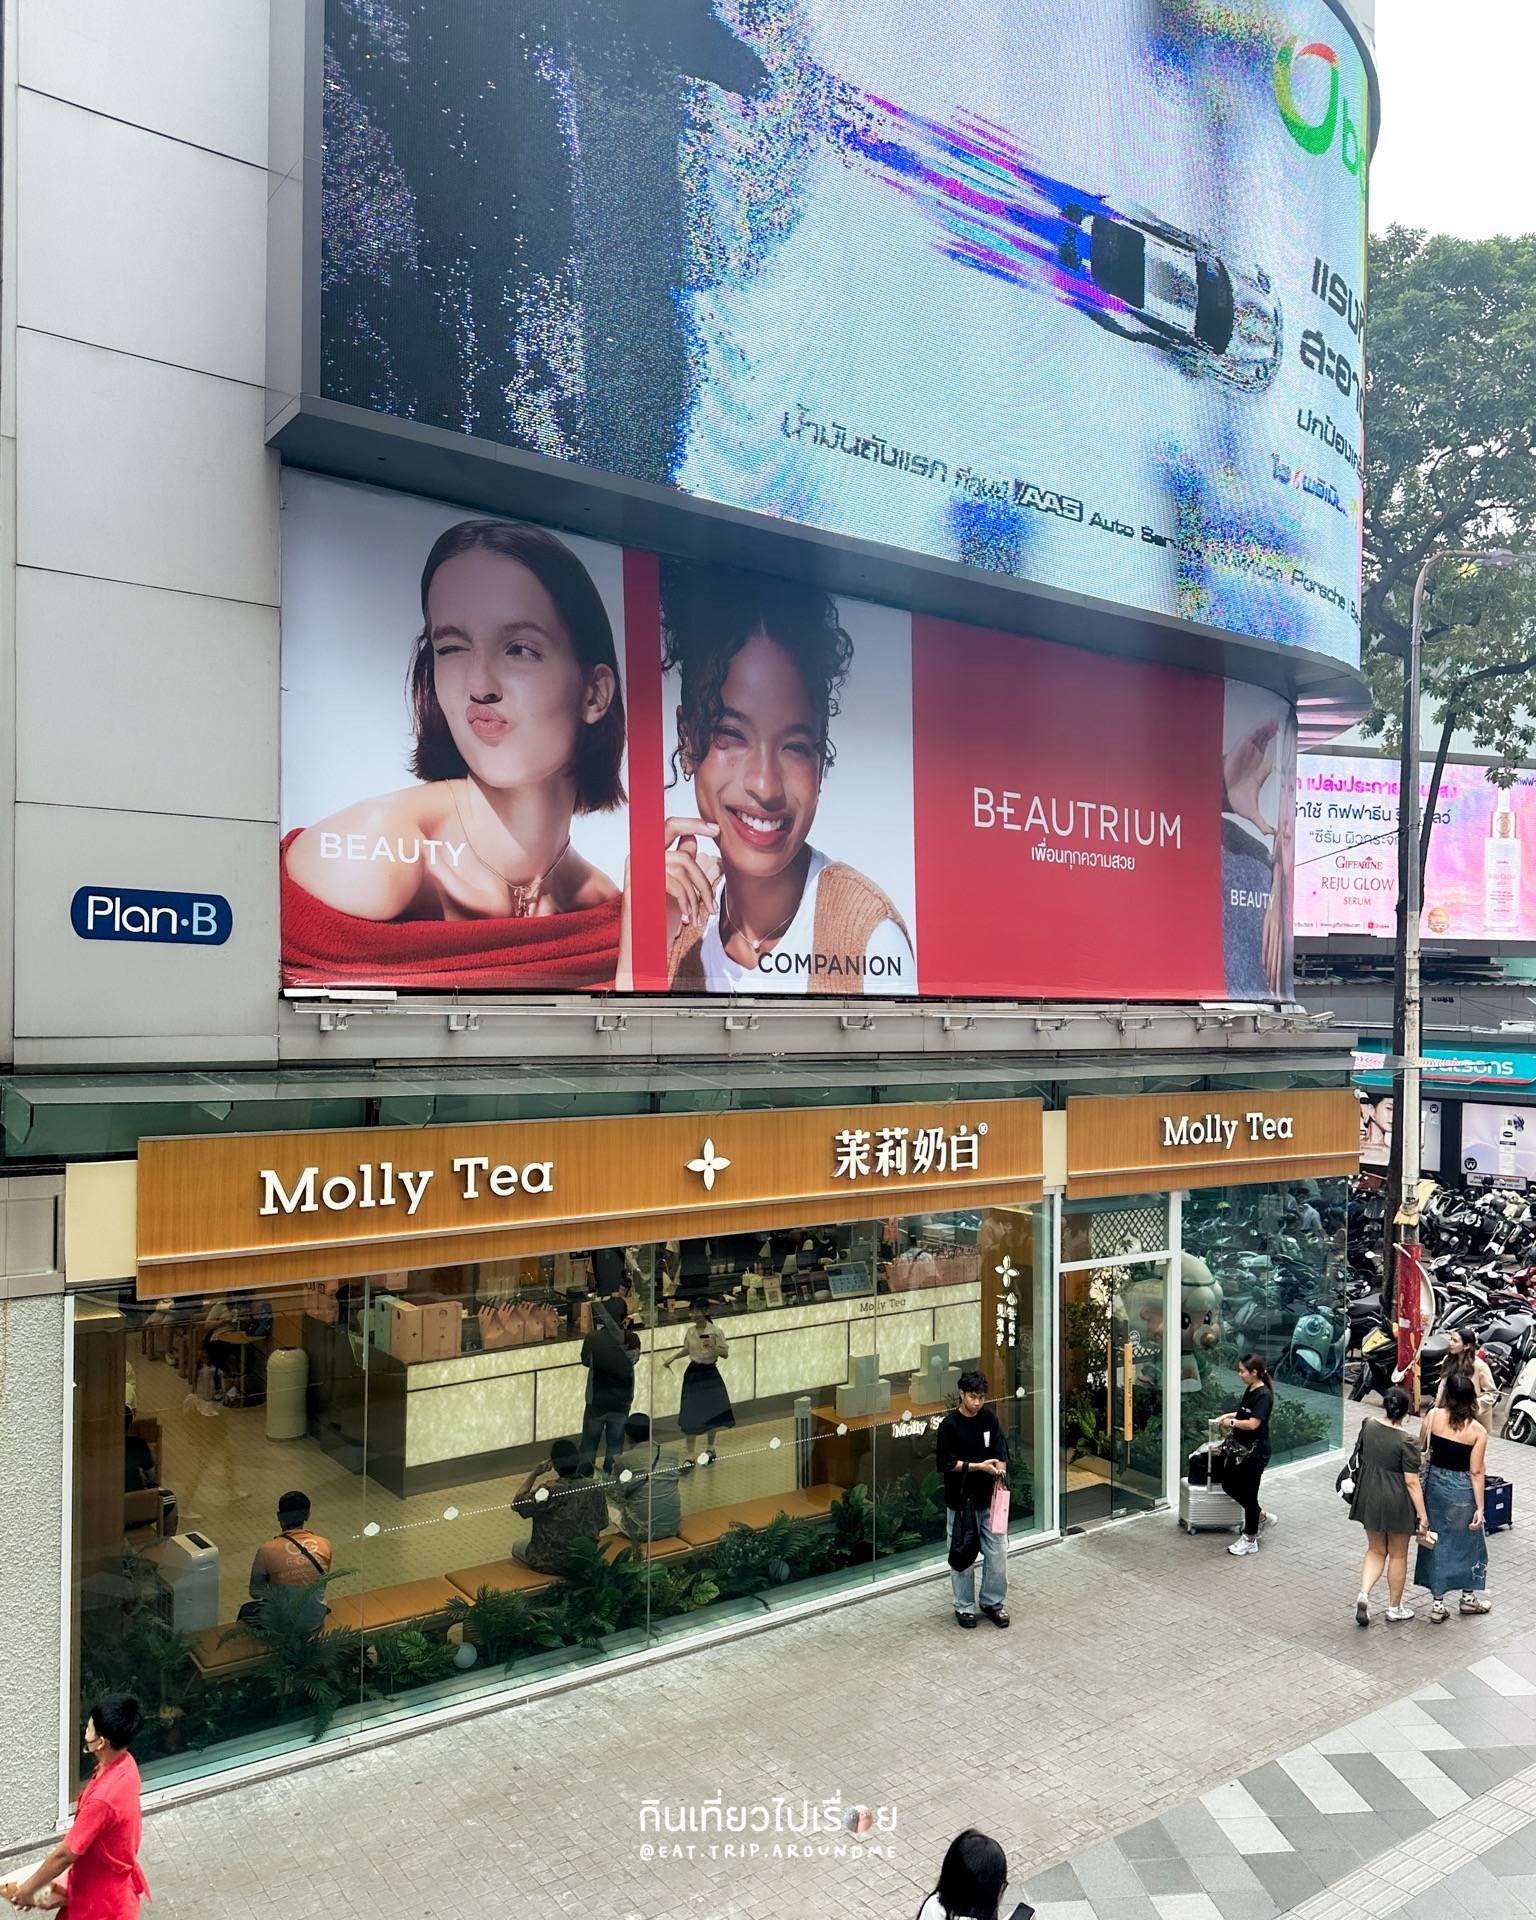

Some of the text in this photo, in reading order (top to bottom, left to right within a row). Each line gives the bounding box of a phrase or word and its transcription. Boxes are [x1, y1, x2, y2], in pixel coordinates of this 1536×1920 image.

[1089, 511, 1135, 538] Auto
[973, 786, 1182, 849] BEAUTRIUM
[319, 831, 467, 868] BEAUTY
[1031, 837, 1136, 871] เพื่อนทุกความสวย
[1322, 876, 1395, 891] REJU GLOW
[1230, 888, 1275, 910] BEAUTY
[1343, 896, 1371, 906] SERUM
[757, 952, 902, 977] COMPANION
[1163, 1113, 1293, 1149] Molly Tea
[259, 1156, 554, 1216] Molly Tea
[892, 1420, 928, 1438] Molly
